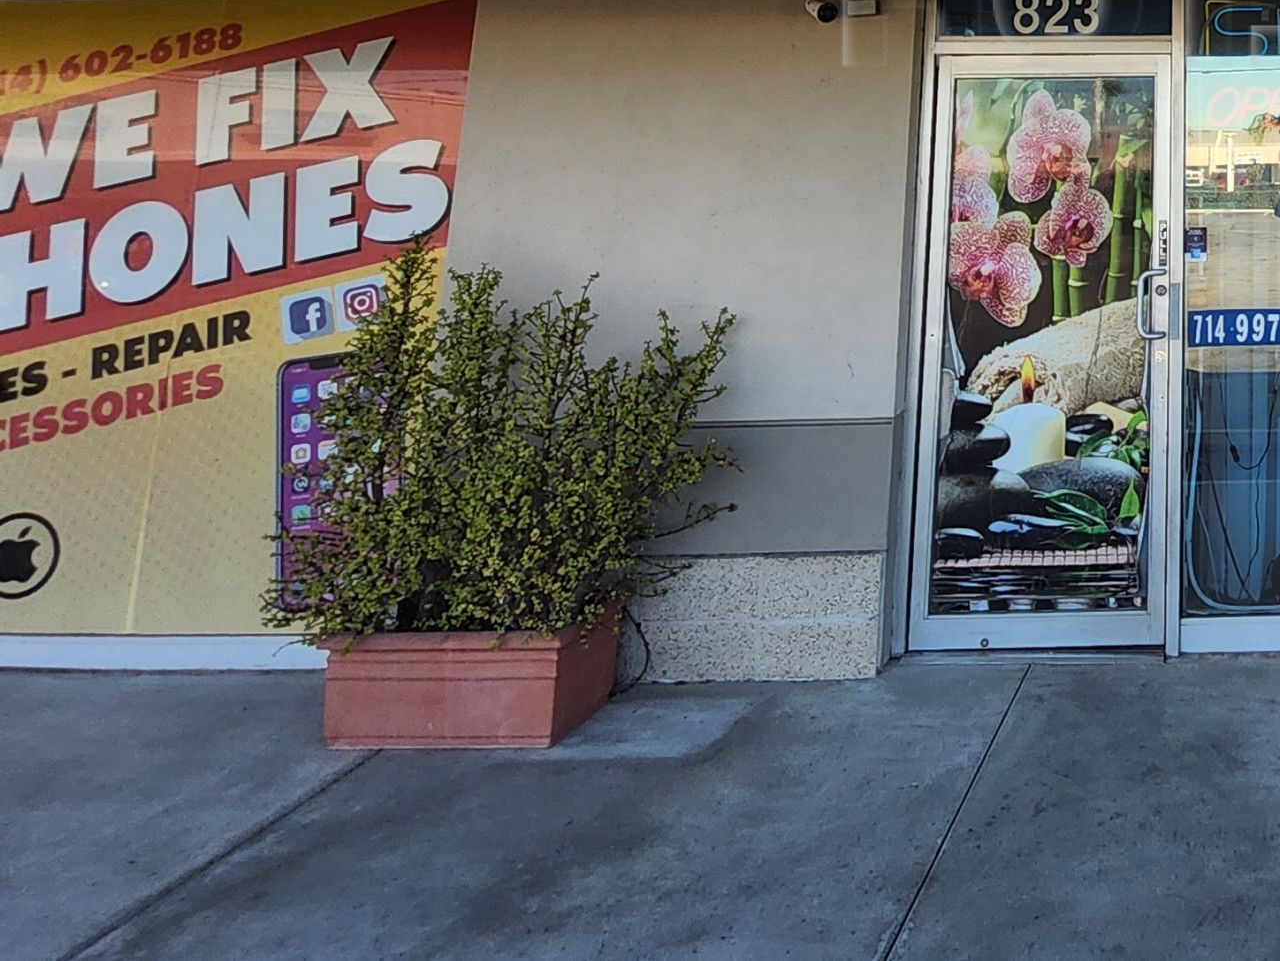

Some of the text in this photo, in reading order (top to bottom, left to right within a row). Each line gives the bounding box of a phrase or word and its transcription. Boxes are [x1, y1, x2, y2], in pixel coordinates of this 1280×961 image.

[59, 23, 243, 83] 602-6188
[0, 36, 397, 213] WE FIX
[1159, 223, 1167, 256] PULL
[91, 310, 252, 380] REPAIR
